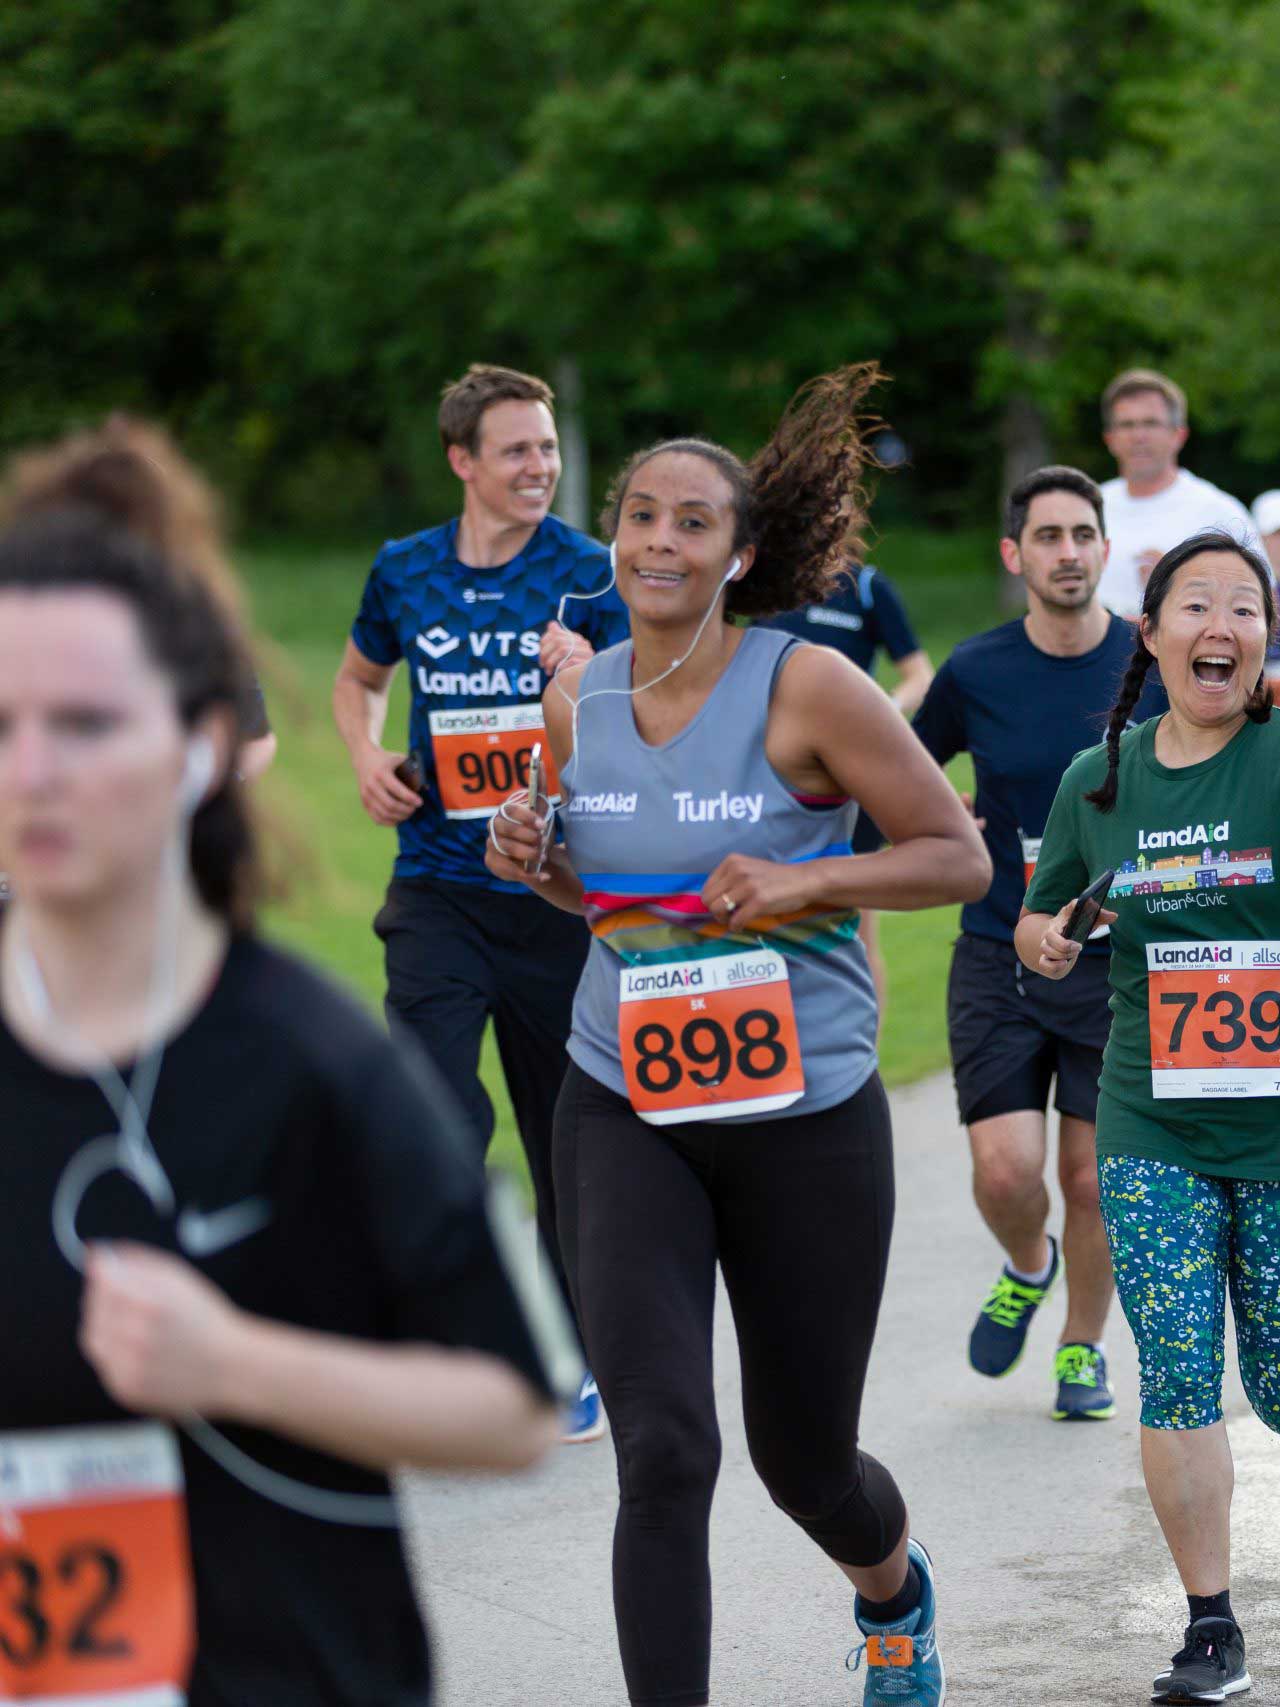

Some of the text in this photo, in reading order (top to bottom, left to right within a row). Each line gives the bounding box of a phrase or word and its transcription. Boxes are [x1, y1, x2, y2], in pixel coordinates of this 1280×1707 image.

[468, 631, 540, 657] VTS
[417, 665, 541, 696] LandAid
[437, 713, 498, 729] LandAid
[568, 792, 638, 813] andAid
[672, 790, 765, 824] Turley
[1138, 821, 1230, 850] LandAid
[1154, 946, 1233, 964] LandAid
[628, 961, 778, 993] LandAid allsop
[1217, 974, 1231, 984] 5K
[690, 998, 706, 1010] 5K
[633, 1009, 788, 1094] 898
